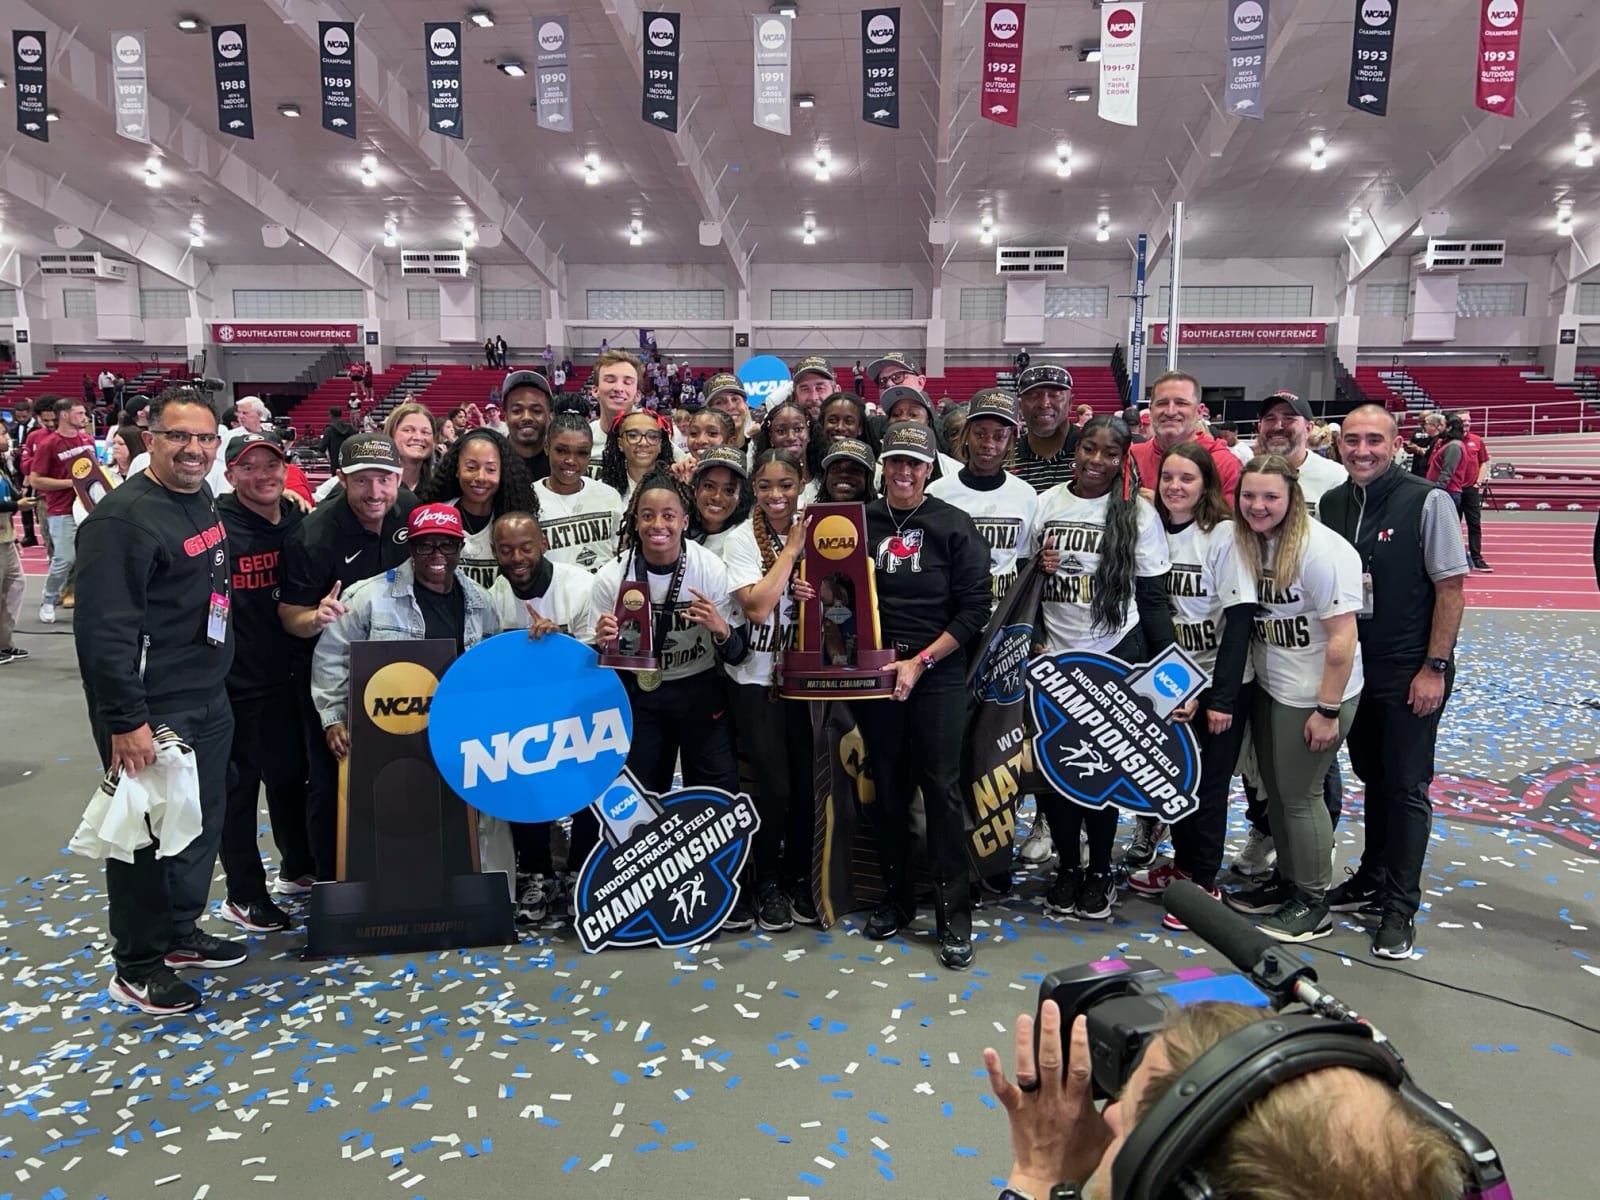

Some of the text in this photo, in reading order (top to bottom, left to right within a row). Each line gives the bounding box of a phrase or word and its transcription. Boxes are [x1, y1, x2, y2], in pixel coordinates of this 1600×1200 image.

[1237, 15, 1261, 24] NCAA
[1364, 10, 1389, 18] NCAA
[1491, 11, 1516, 19] NCAA
[870, 28, 893, 37] NCAA
[993, 23, 1016, 31] NCAA
[1110, 23, 1135, 32] NCAA
[542, 35, 563, 44] NCAA
[651, 31, 673, 40] NCAA
[220, 43, 241, 51] NCAA
[327, 40, 349, 48] NCAA
[1232, 55, 1261, 67] 1992
[1357, 50, 1388, 61] 1993
[1484, 50, 1515, 61] 1993
[867, 67, 894, 78] 1992
[988, 62, 1016, 73] 1992
[540, 73, 566, 84] 1990
[649, 70, 673, 80] 1991
[761, 72, 784, 82] 1991
[220, 80, 246, 90] 1988
[324, 76, 351, 88] 1989
[432, 79, 459, 88] 1990
[1230, 82, 1260, 90] COUNTRY
[19, 84, 43, 93] 1987
[119, 85, 143, 94] 1987
[414, 508, 458, 527] Georgia
[541, 518, 610, 550] ATIONA
[818, 537, 856, 550] NCAA
[807, 679, 875, 689] NATIONAL CHAMPION
[1156, 671, 1184, 697] NCAA
[1103, 680, 1168, 745] 2026 DI
[1070, 667, 1180, 777] INDOOR TRACK & FIELD
[1030, 661, 1188, 815] CHAMPIONSHIPS
[460, 708, 630, 790] NCAA
[609, 793, 638, 818] NCAA
[612, 813, 683, 871] 2026 DI
[594, 807, 716, 901] INDOOR TRACK & FIELD
[582, 802, 752, 942] CHAMPIONSHIPS
[355, 924, 408, 937] NATIONAL
